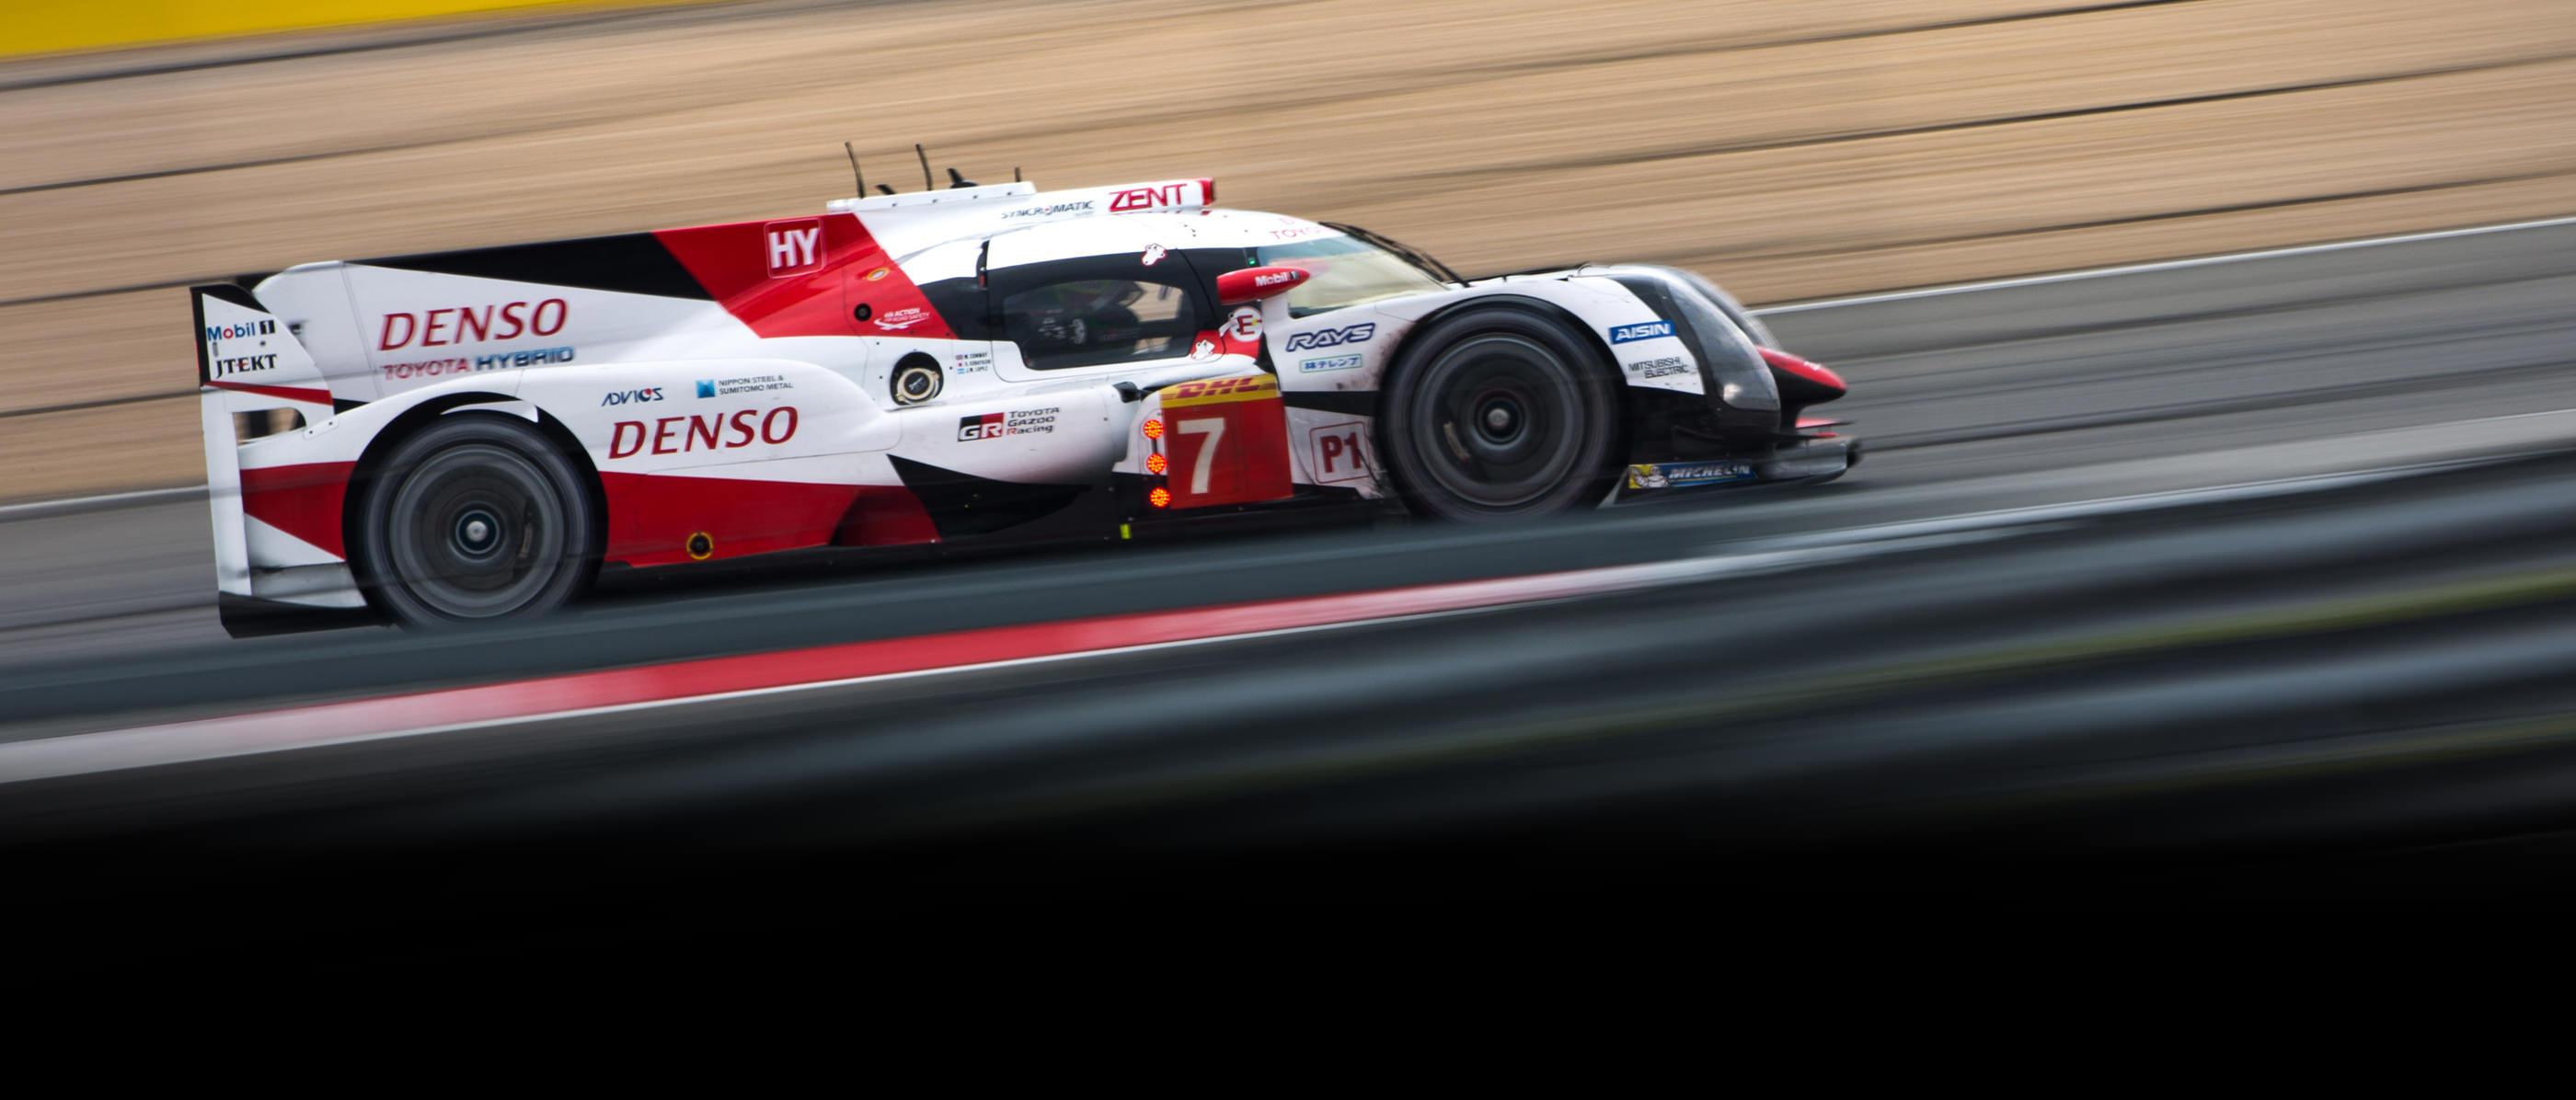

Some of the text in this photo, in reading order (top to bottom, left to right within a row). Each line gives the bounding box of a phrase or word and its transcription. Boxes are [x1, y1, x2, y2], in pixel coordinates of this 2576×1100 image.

[1109, 183, 1187, 212] ZENT
[768, 227, 820, 269] HY
[1254, 271, 1288, 287] Mobil
[206, 319, 275, 341] Mobil 1
[378, 298, 569, 351] DENSO
[1616, 323, 1672, 341] AISIN
[1285, 322, 1376, 352] RAYS
[215, 353, 277, 379] JTEKT
[381, 347, 575, 380] TOYOTA HYBRID
[1627, 357, 1681, 372] MITSUBISHI
[1644, 364, 1690, 379] ELECTRIC
[719, 377, 751, 387] NIPPON
[719, 382, 793, 395] SUMITOMO METAL
[1175, 377, 1260, 399] DHL
[602, 387, 665, 407] ADVICS
[1007, 416, 1055, 429] GAZOO
[1009, 407, 1061, 419] TOYOTA
[608, 406, 799, 460] DENSO
[958, 422, 1003, 441] GR
[1006, 425, 1053, 436] Racing
[1177, 418, 1225, 495] 7
[1319, 431, 1363, 475] P1
